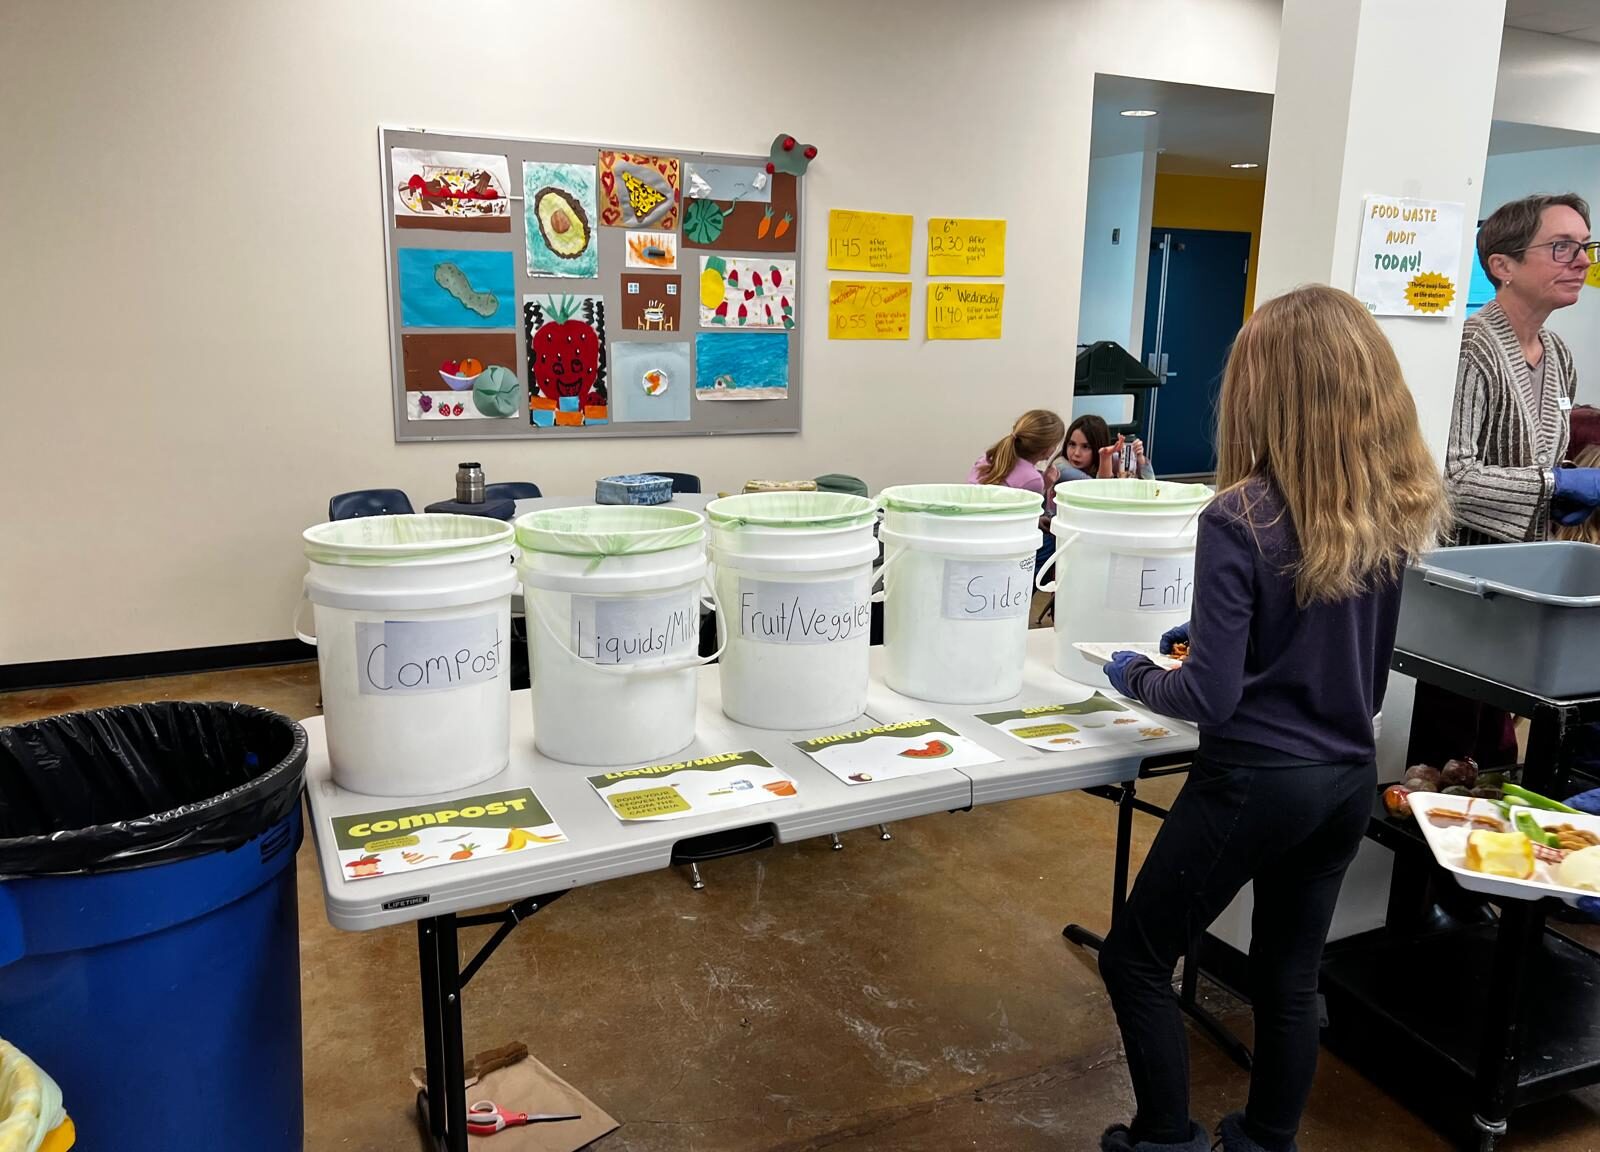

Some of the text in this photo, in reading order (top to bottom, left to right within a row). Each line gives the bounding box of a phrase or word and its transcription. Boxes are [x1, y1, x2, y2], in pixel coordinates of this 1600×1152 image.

[1371, 204, 1438, 222] FOOD WASTE
[943, 219, 959, 233] 6th
[1385, 230, 1417, 245] AUDIT
[1374, 250, 1422, 273] TODAY!
[934, 283, 1000, 308] 6th Wednesday
[1438, 282, 1451, 290] food
[965, 575, 1029, 614] Sides
[741, 592, 869, 641] Fruit/Veggies
[578, 607, 698, 663] Liquids/Milk
[367, 628, 503, 691] Compost
[626, 803, 655, 811] FROM
[387, 897, 424, 909] LIFETIME
